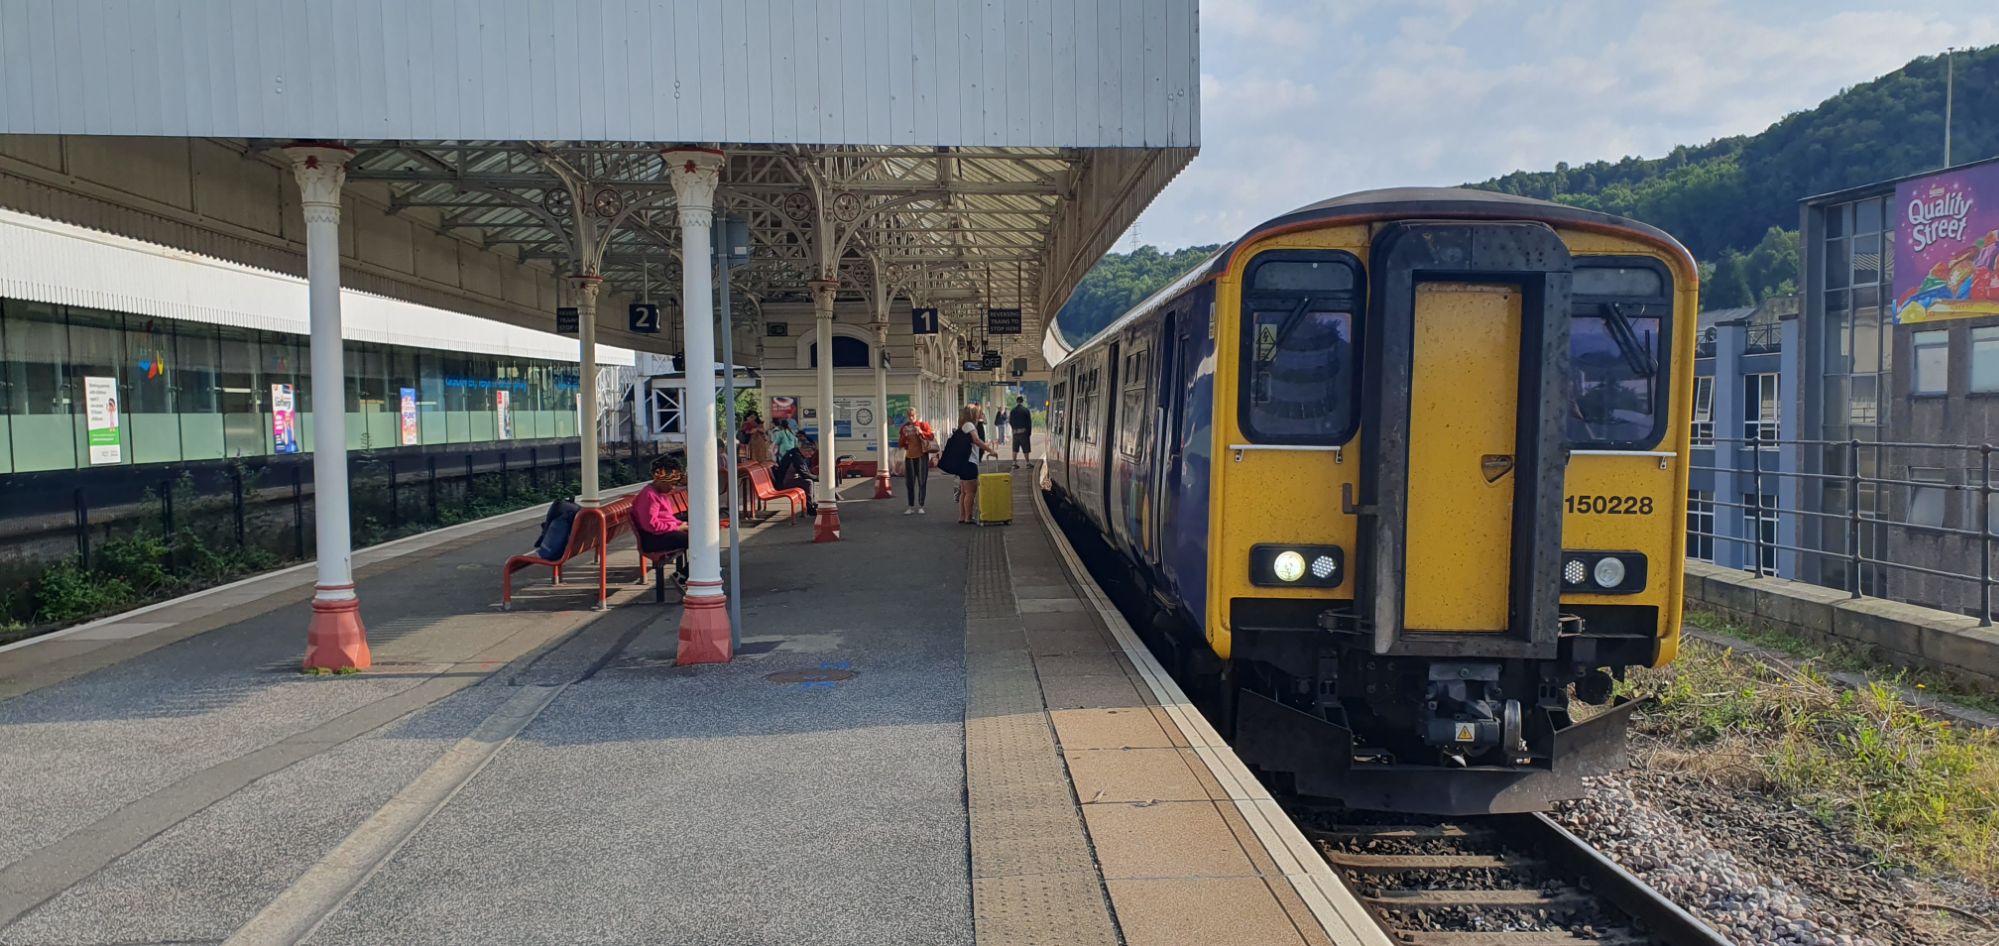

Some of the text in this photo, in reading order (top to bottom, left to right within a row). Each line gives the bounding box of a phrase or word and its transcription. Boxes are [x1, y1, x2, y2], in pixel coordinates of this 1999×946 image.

[1908, 192, 1974, 224] Quality
[1913, 216, 1967, 251] Street
[635, 307, 649, 327] 2
[920, 311, 931, 331] 1
[985, 357, 1000, 366] OFF
[1565, 495, 1654, 515] 150228
